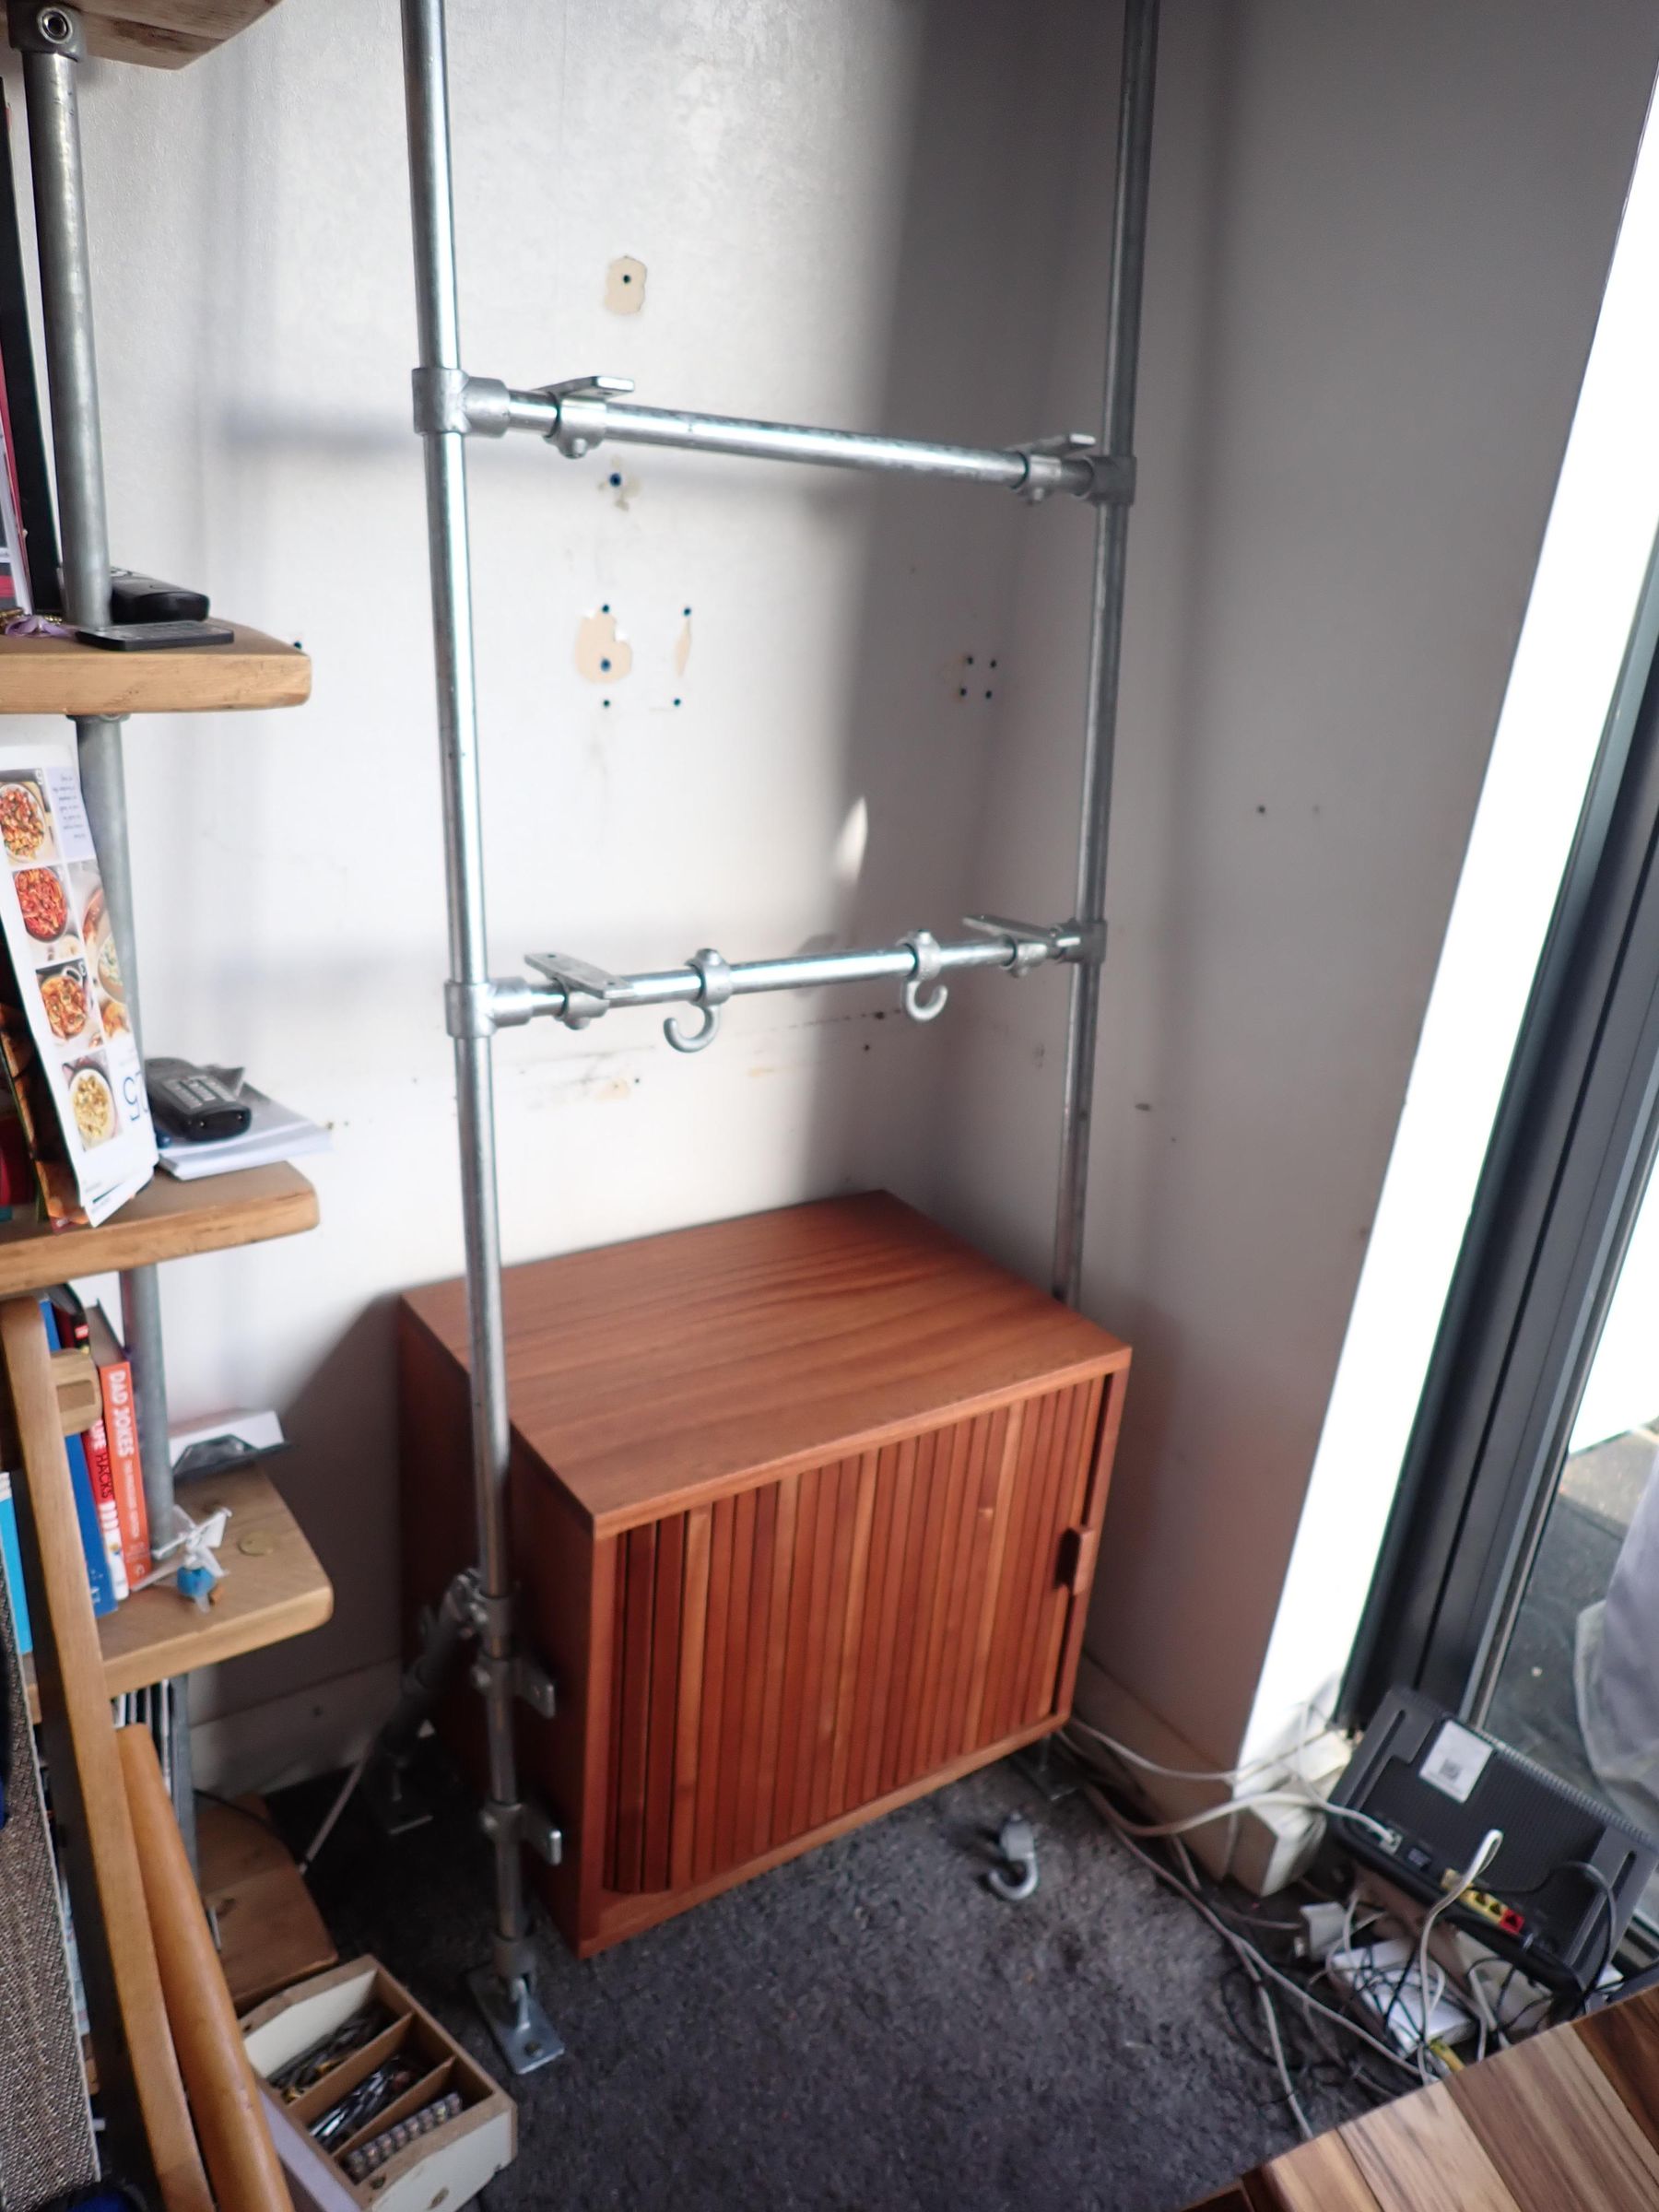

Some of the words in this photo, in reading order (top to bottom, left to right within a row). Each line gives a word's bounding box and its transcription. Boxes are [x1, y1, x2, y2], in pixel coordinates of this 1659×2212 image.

[109, 1370, 128, 1405] DAD
[113, 1407, 135, 1457] JOKES
[96, 1453, 112, 1499] HACKS
